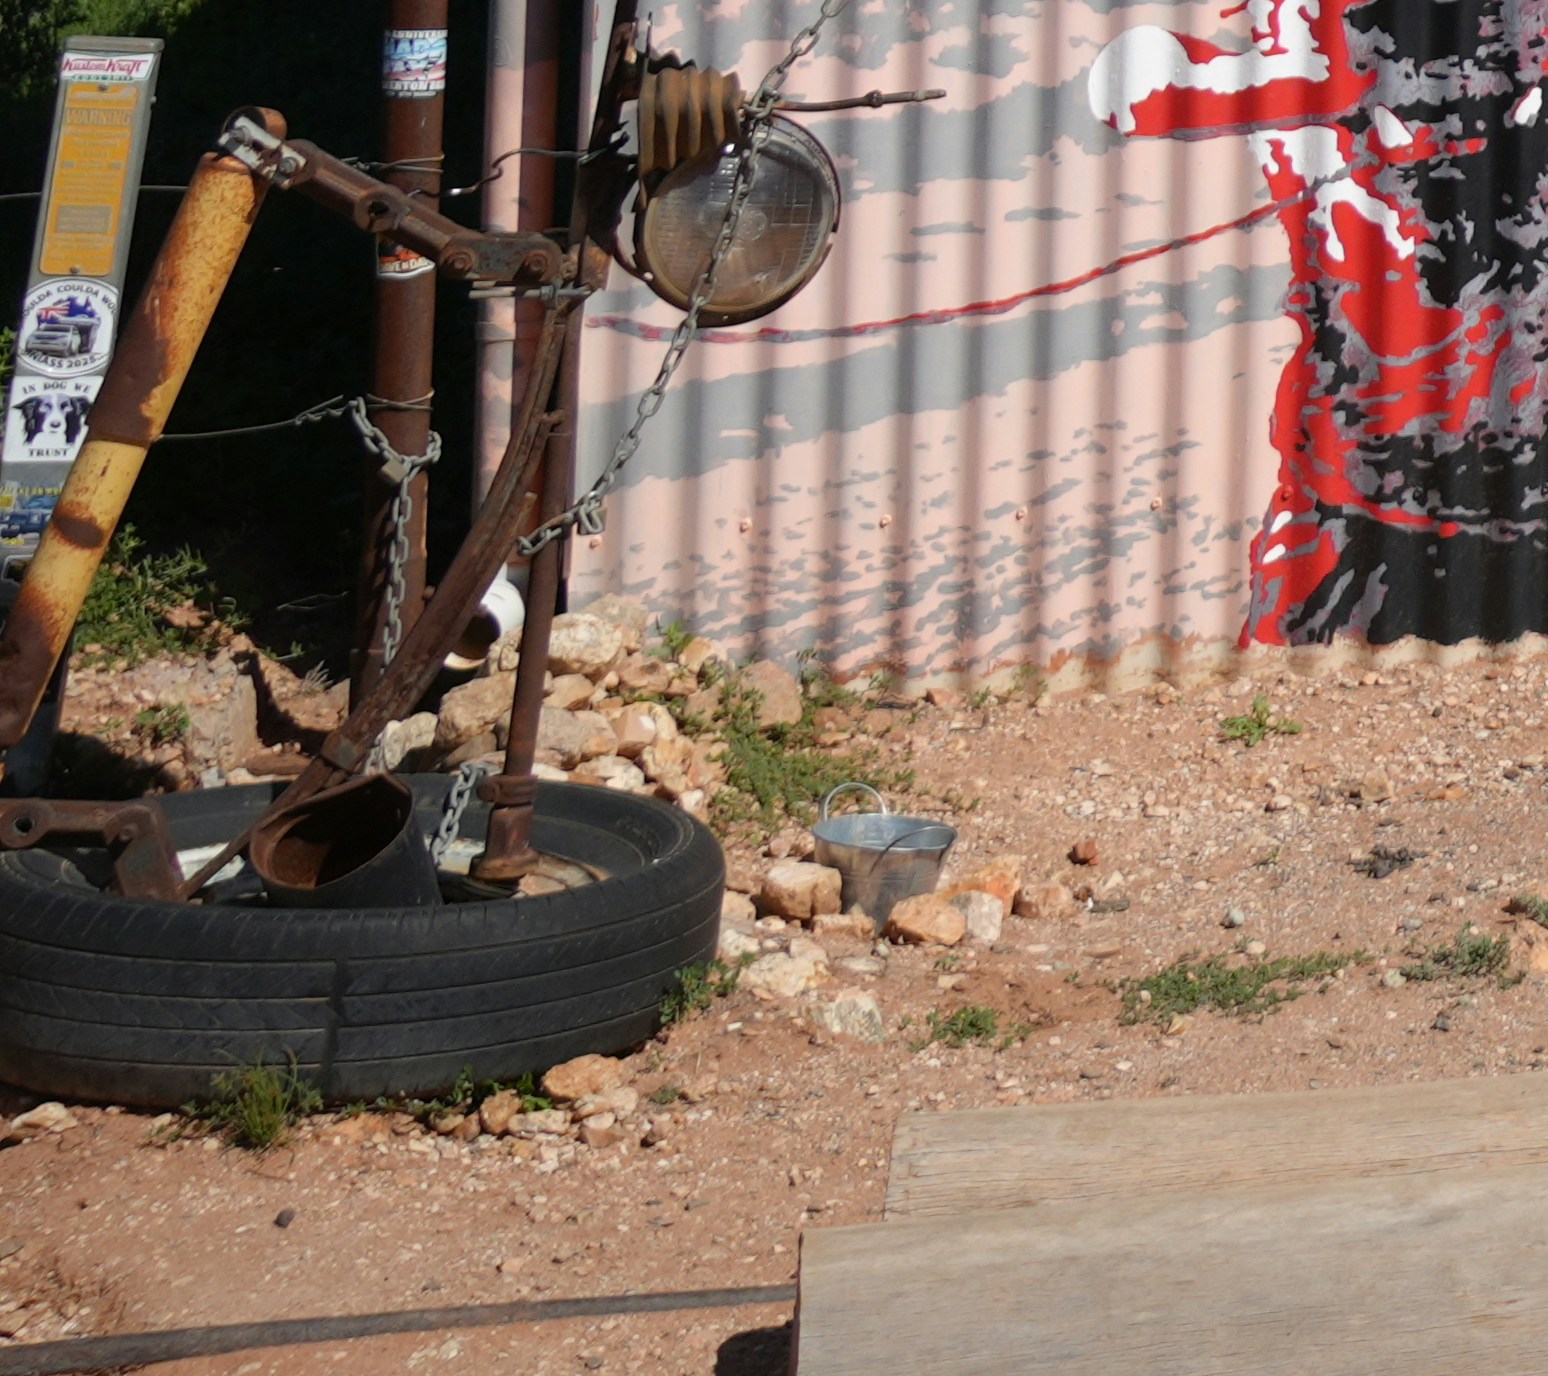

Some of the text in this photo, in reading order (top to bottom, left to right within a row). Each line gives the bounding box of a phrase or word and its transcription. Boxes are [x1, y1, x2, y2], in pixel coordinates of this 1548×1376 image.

[66, 107, 133, 126] WARNING
[57, 284, 100, 297] COULDA
[43, 381, 68, 391] DOG
[28, 448, 70, 458] TRUST
